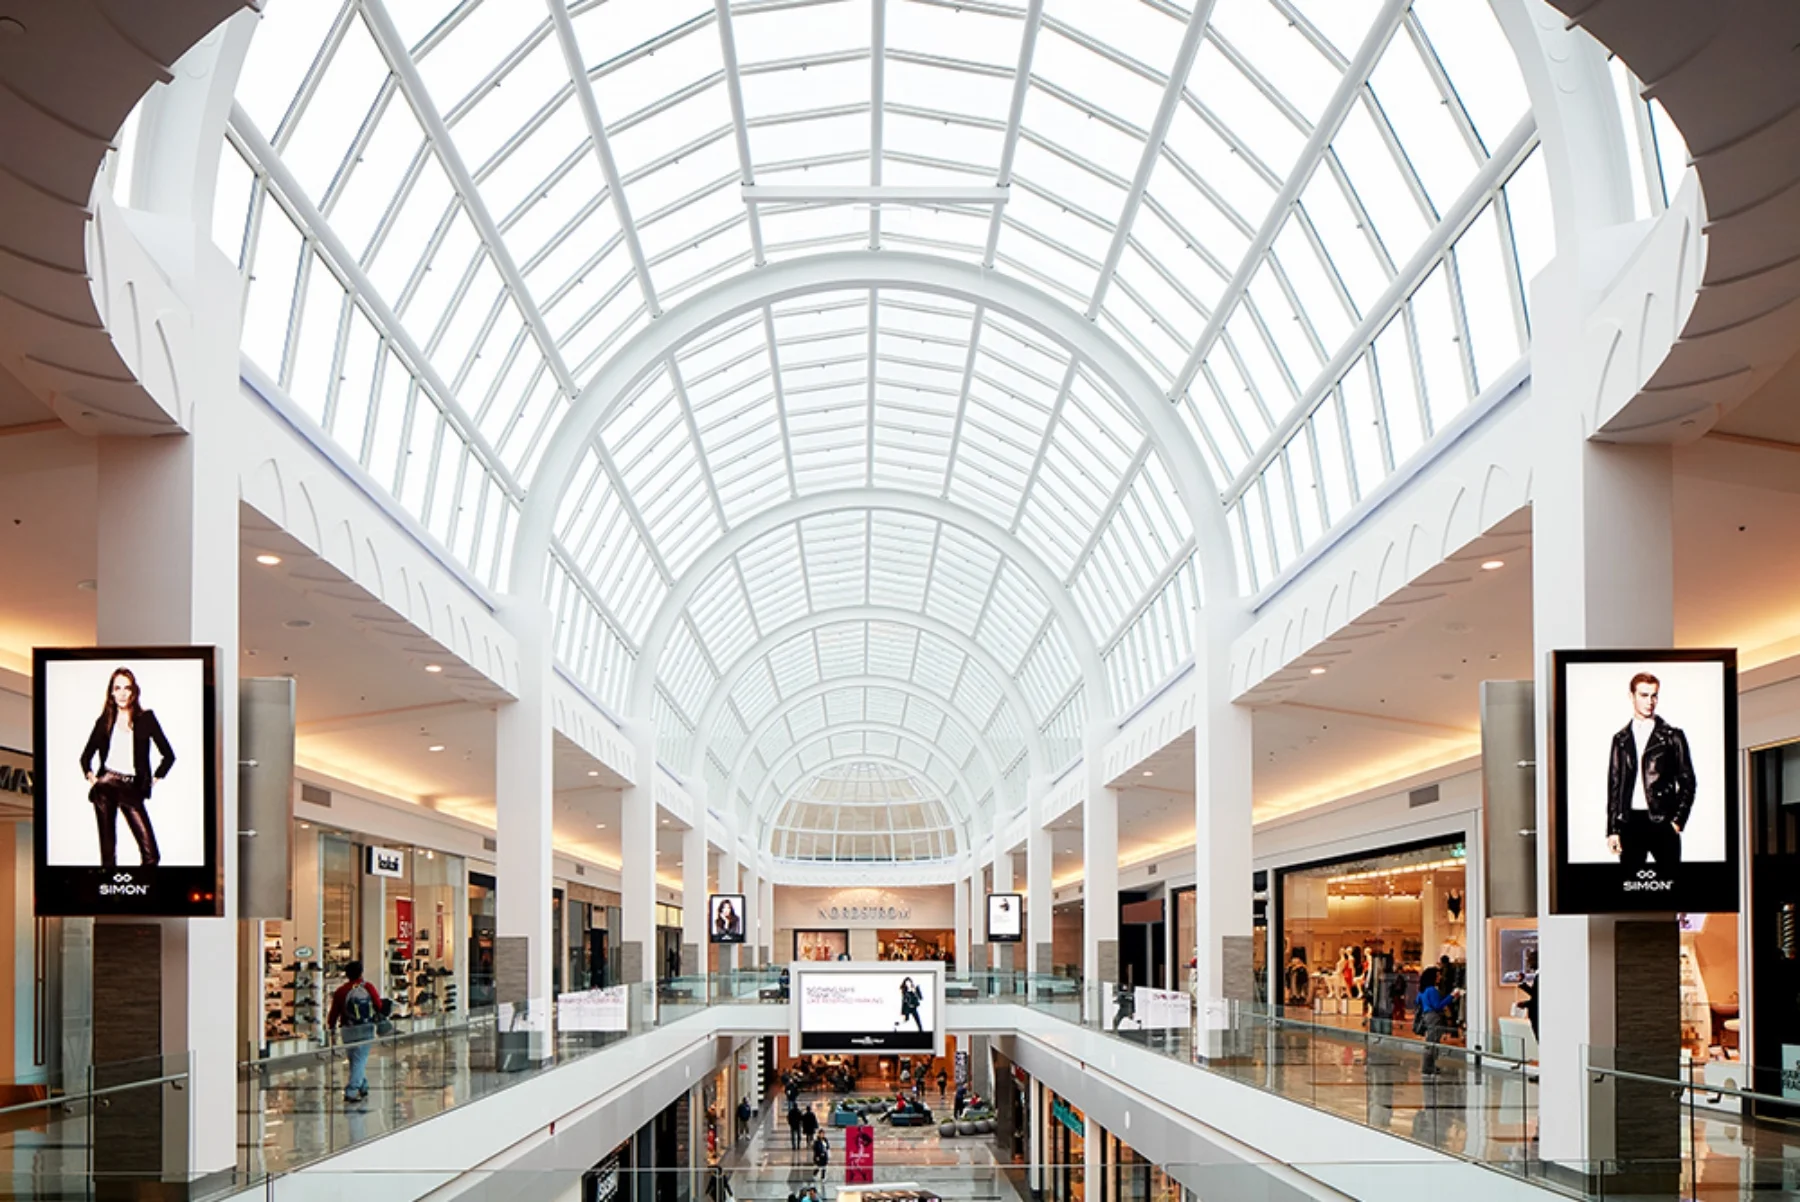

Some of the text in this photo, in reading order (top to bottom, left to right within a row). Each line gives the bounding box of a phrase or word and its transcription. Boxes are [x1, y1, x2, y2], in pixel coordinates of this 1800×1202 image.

[99, 884, 147, 895] SIMON
[1623, 880, 1671, 891] SIMON
[818, 906, 911, 920] NORDSTROM
